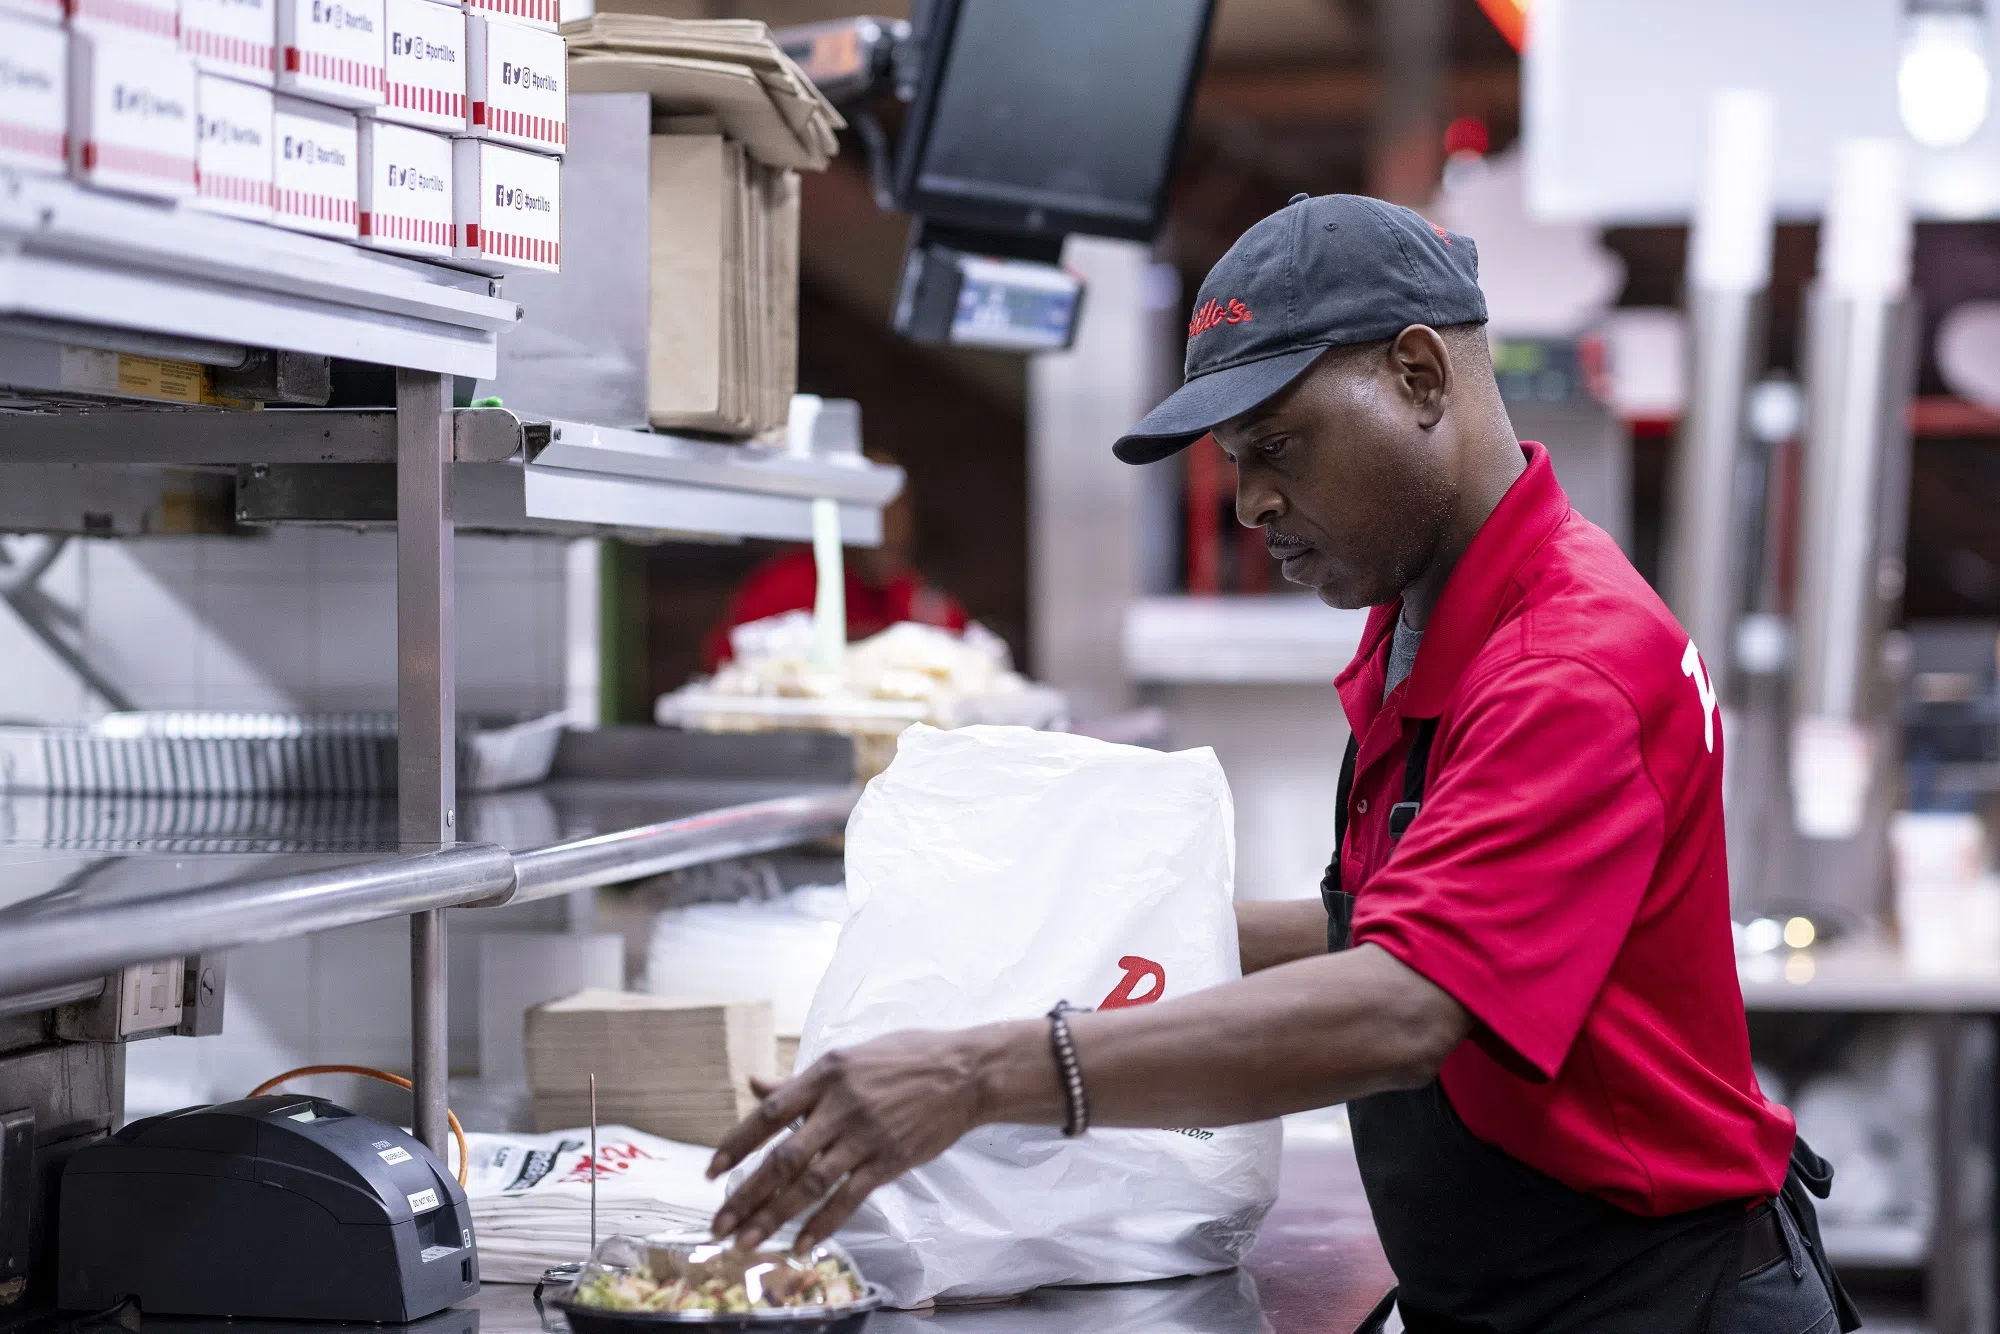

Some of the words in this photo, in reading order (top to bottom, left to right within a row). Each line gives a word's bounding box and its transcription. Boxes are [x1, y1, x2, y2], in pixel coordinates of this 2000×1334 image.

[426, 41, 455, 63] #portillos
[532, 72, 557, 92] #portillos
[525, 193, 550, 213] #portillos
